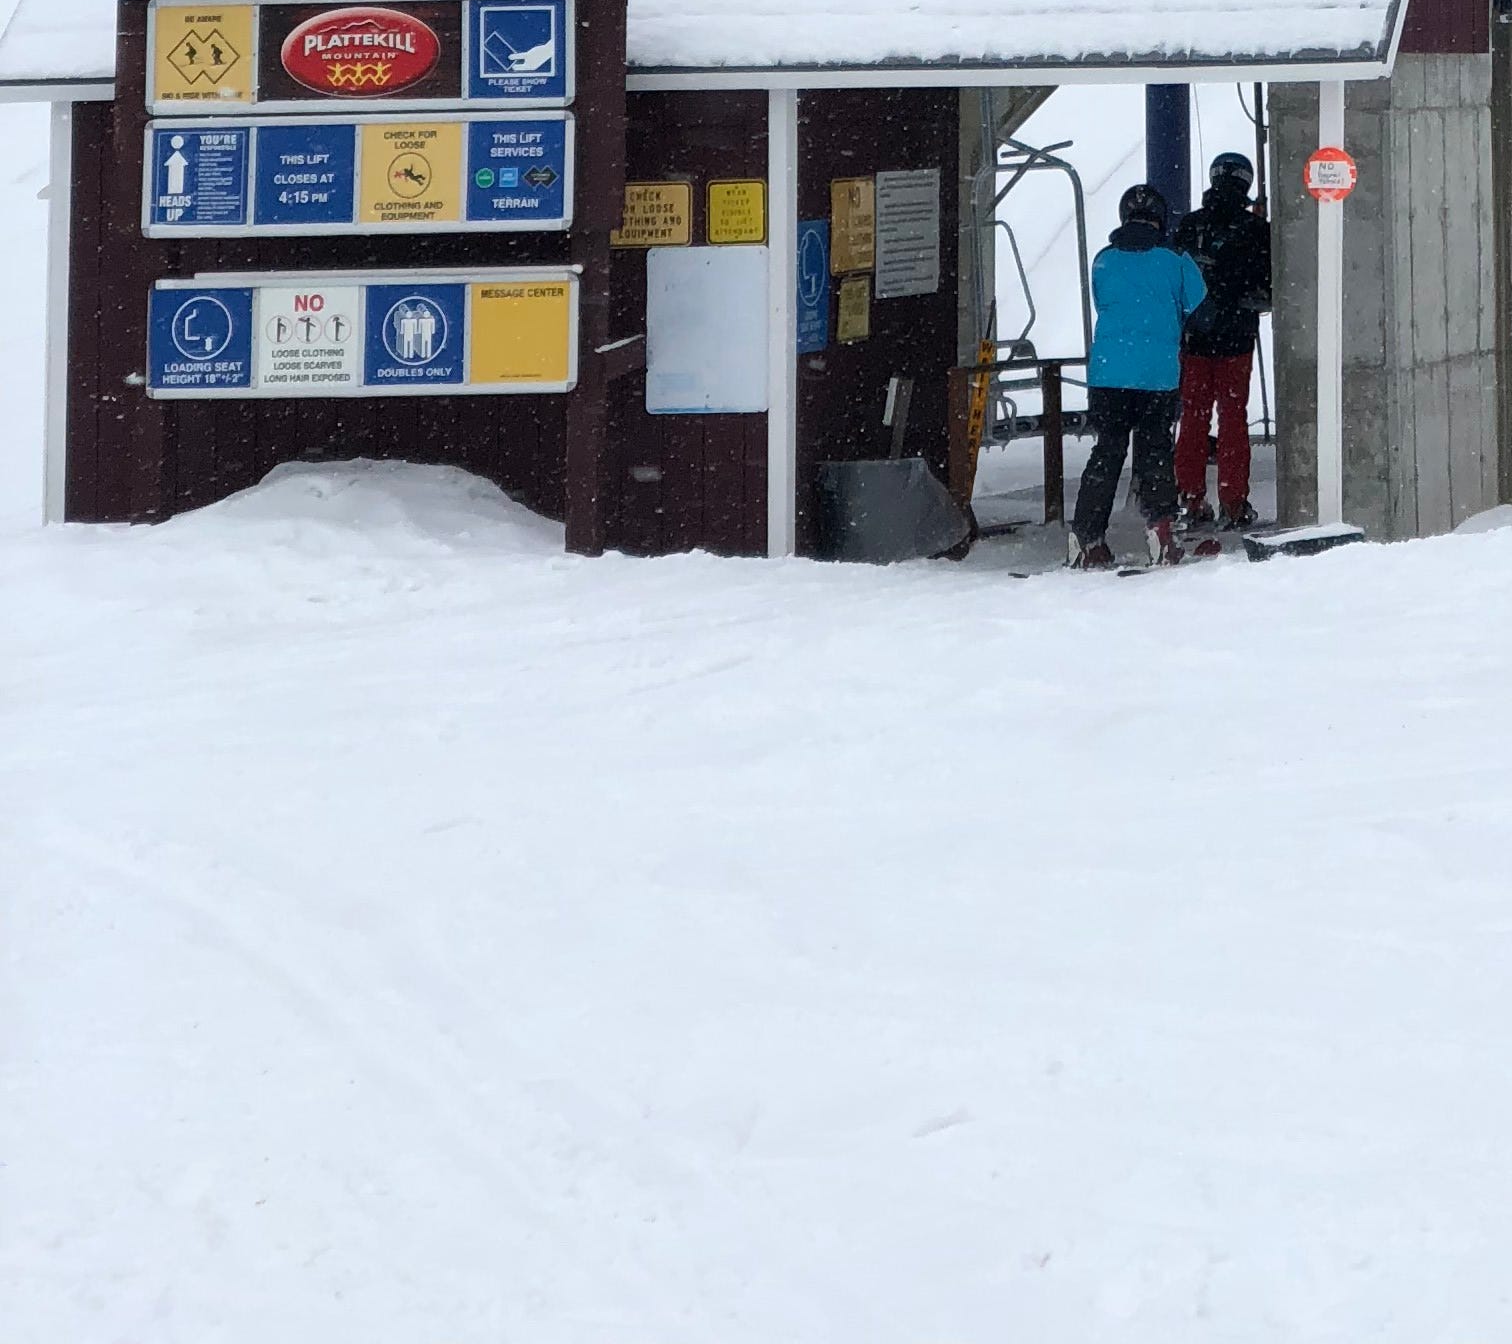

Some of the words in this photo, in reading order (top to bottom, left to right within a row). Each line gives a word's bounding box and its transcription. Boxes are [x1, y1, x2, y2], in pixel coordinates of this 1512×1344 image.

[184, 15, 195, 23] BE
[197, 15, 222, 23] AWARE
[304, 32, 416, 56] PLATTEKILL
[321, 52, 396, 60] MOUNTAIN
[488, 78, 520, 86] PLEASE
[503, 85, 532, 93] TICKET
[199, 134, 237, 145] YOU'RE
[383, 131, 416, 140] CHECK
[418, 130, 438, 139] FOR
[492, 133, 517, 144] THIS
[519, 132, 543, 143] LIFT
[394, 141, 426, 150] LOOSE
[489, 147, 544, 158] SERVICES
[280, 155, 305, 165] THIS
[306, 154, 330, 164] LIFT
[1318, 162, 1335, 171] NO
[273, 174, 318, 185] CLOSES
[319, 173, 335, 183] AT
[159, 195, 192, 207] HEADS
[278, 190, 309, 204] 4:15
[311, 193, 328, 203] PM
[629, 191, 662, 202] CHECK
[374, 201, 422, 211] CLOTHING
[423, 201, 444, 210] AND
[491, 198, 540, 209] TERRAIN
[624, 204, 636, 214] OR
[642, 203, 675, 214] LOOSE
[166, 208, 184, 222] UP
[381, 211, 436, 221] EQUIPMENT
[623, 216, 657, 226] OTHING
[662, 216, 682, 226] AND
[480, 288, 526, 299] MESSAGE
[527, 287, 565, 298] CENTER
[294, 294, 325, 312] NO
[271, 349, 300, 358] LOOSE
[301, 348, 345, 358] CLOTHING
[164, 362, 213, 373] LOADING
[214, 361, 243, 372] SEAT
[273, 361, 302, 370] LOOSE
[303, 360, 343, 370] SCARVES
[263, 374, 288, 383] LONG
[289, 374, 310, 382] HAIR
[311, 373, 351, 382] EXPOSED
[377, 368, 424, 378] DOUBLES
[425, 367, 453, 377] ONLY
[162, 374, 202, 385] HEIGHT
